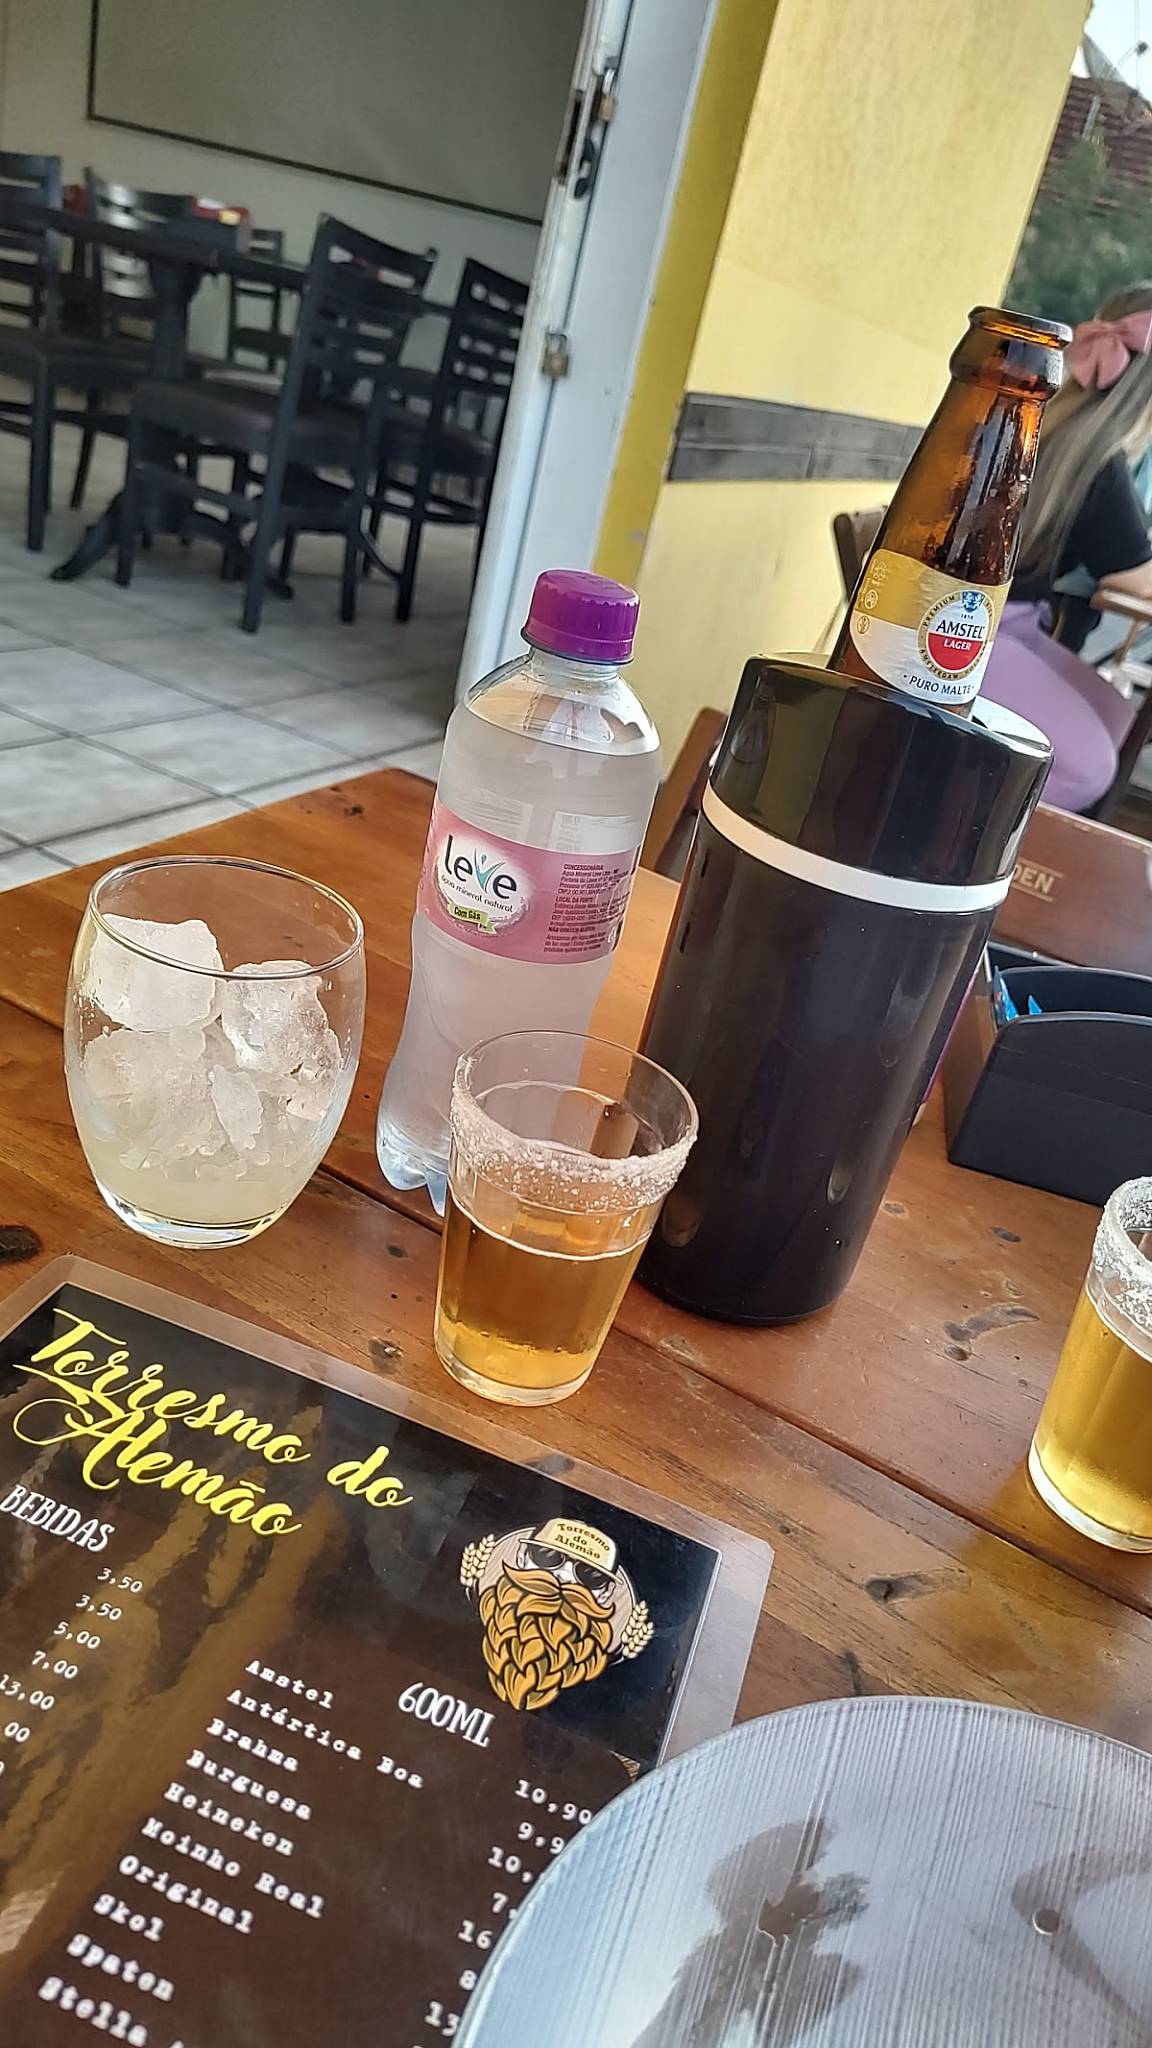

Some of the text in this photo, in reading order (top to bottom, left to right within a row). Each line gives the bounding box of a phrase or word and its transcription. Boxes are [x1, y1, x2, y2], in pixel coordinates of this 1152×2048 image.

[935, 619, 984, 639] AMSTEL
[943, 638, 972, 651] LAGER
[909, 675, 973, 696] PURO MALTE
[454, 906, 467, 918] Com
[456, 886, 482, 901] mineral
[484, 898, 514, 913] natural
[31, 1308, 413, 1508] Torresmo do
[13, 1382, 302, 1535] Alemão
[0, 1484, 115, 1553] BEBIDAS
[557, 1523, 610, 1551] Torresmo
[554, 1534, 601, 1559] Alemão
[573, 1536, 587, 1545] do
[97, 1567, 143, 1593] 3,50
[75, 1594, 122, 1620] 3,50
[53, 1621, 101, 1649] 5,00
[31, 1651, 79, 1680] 7,00
[0, 1674, 55, 1710] 13,00
[1, 1722, 31, 1742] 00
[398, 1682, 496, 1748] 600ML
[206, 1718, 299, 1772] Brahma
[226, 1689, 362, 1761] Antártica
[376, 1756, 424, 1789] Boa
[245, 1659, 593, 1825] Amstel 10,90
[186, 1749, 312, 1821] Burguesa
[163, 1782, 294, 1856] Heineken
[141, 1817, 240, 1877] Moinho
[254, 1872, 324, 1918] Real
[119, 1855, 253, 1934] Original
[93, 1893, 165, 1942] Skol
[66, 1933, 174, 2001] Spaten
[38, 1976, 148, 2048] Stella
